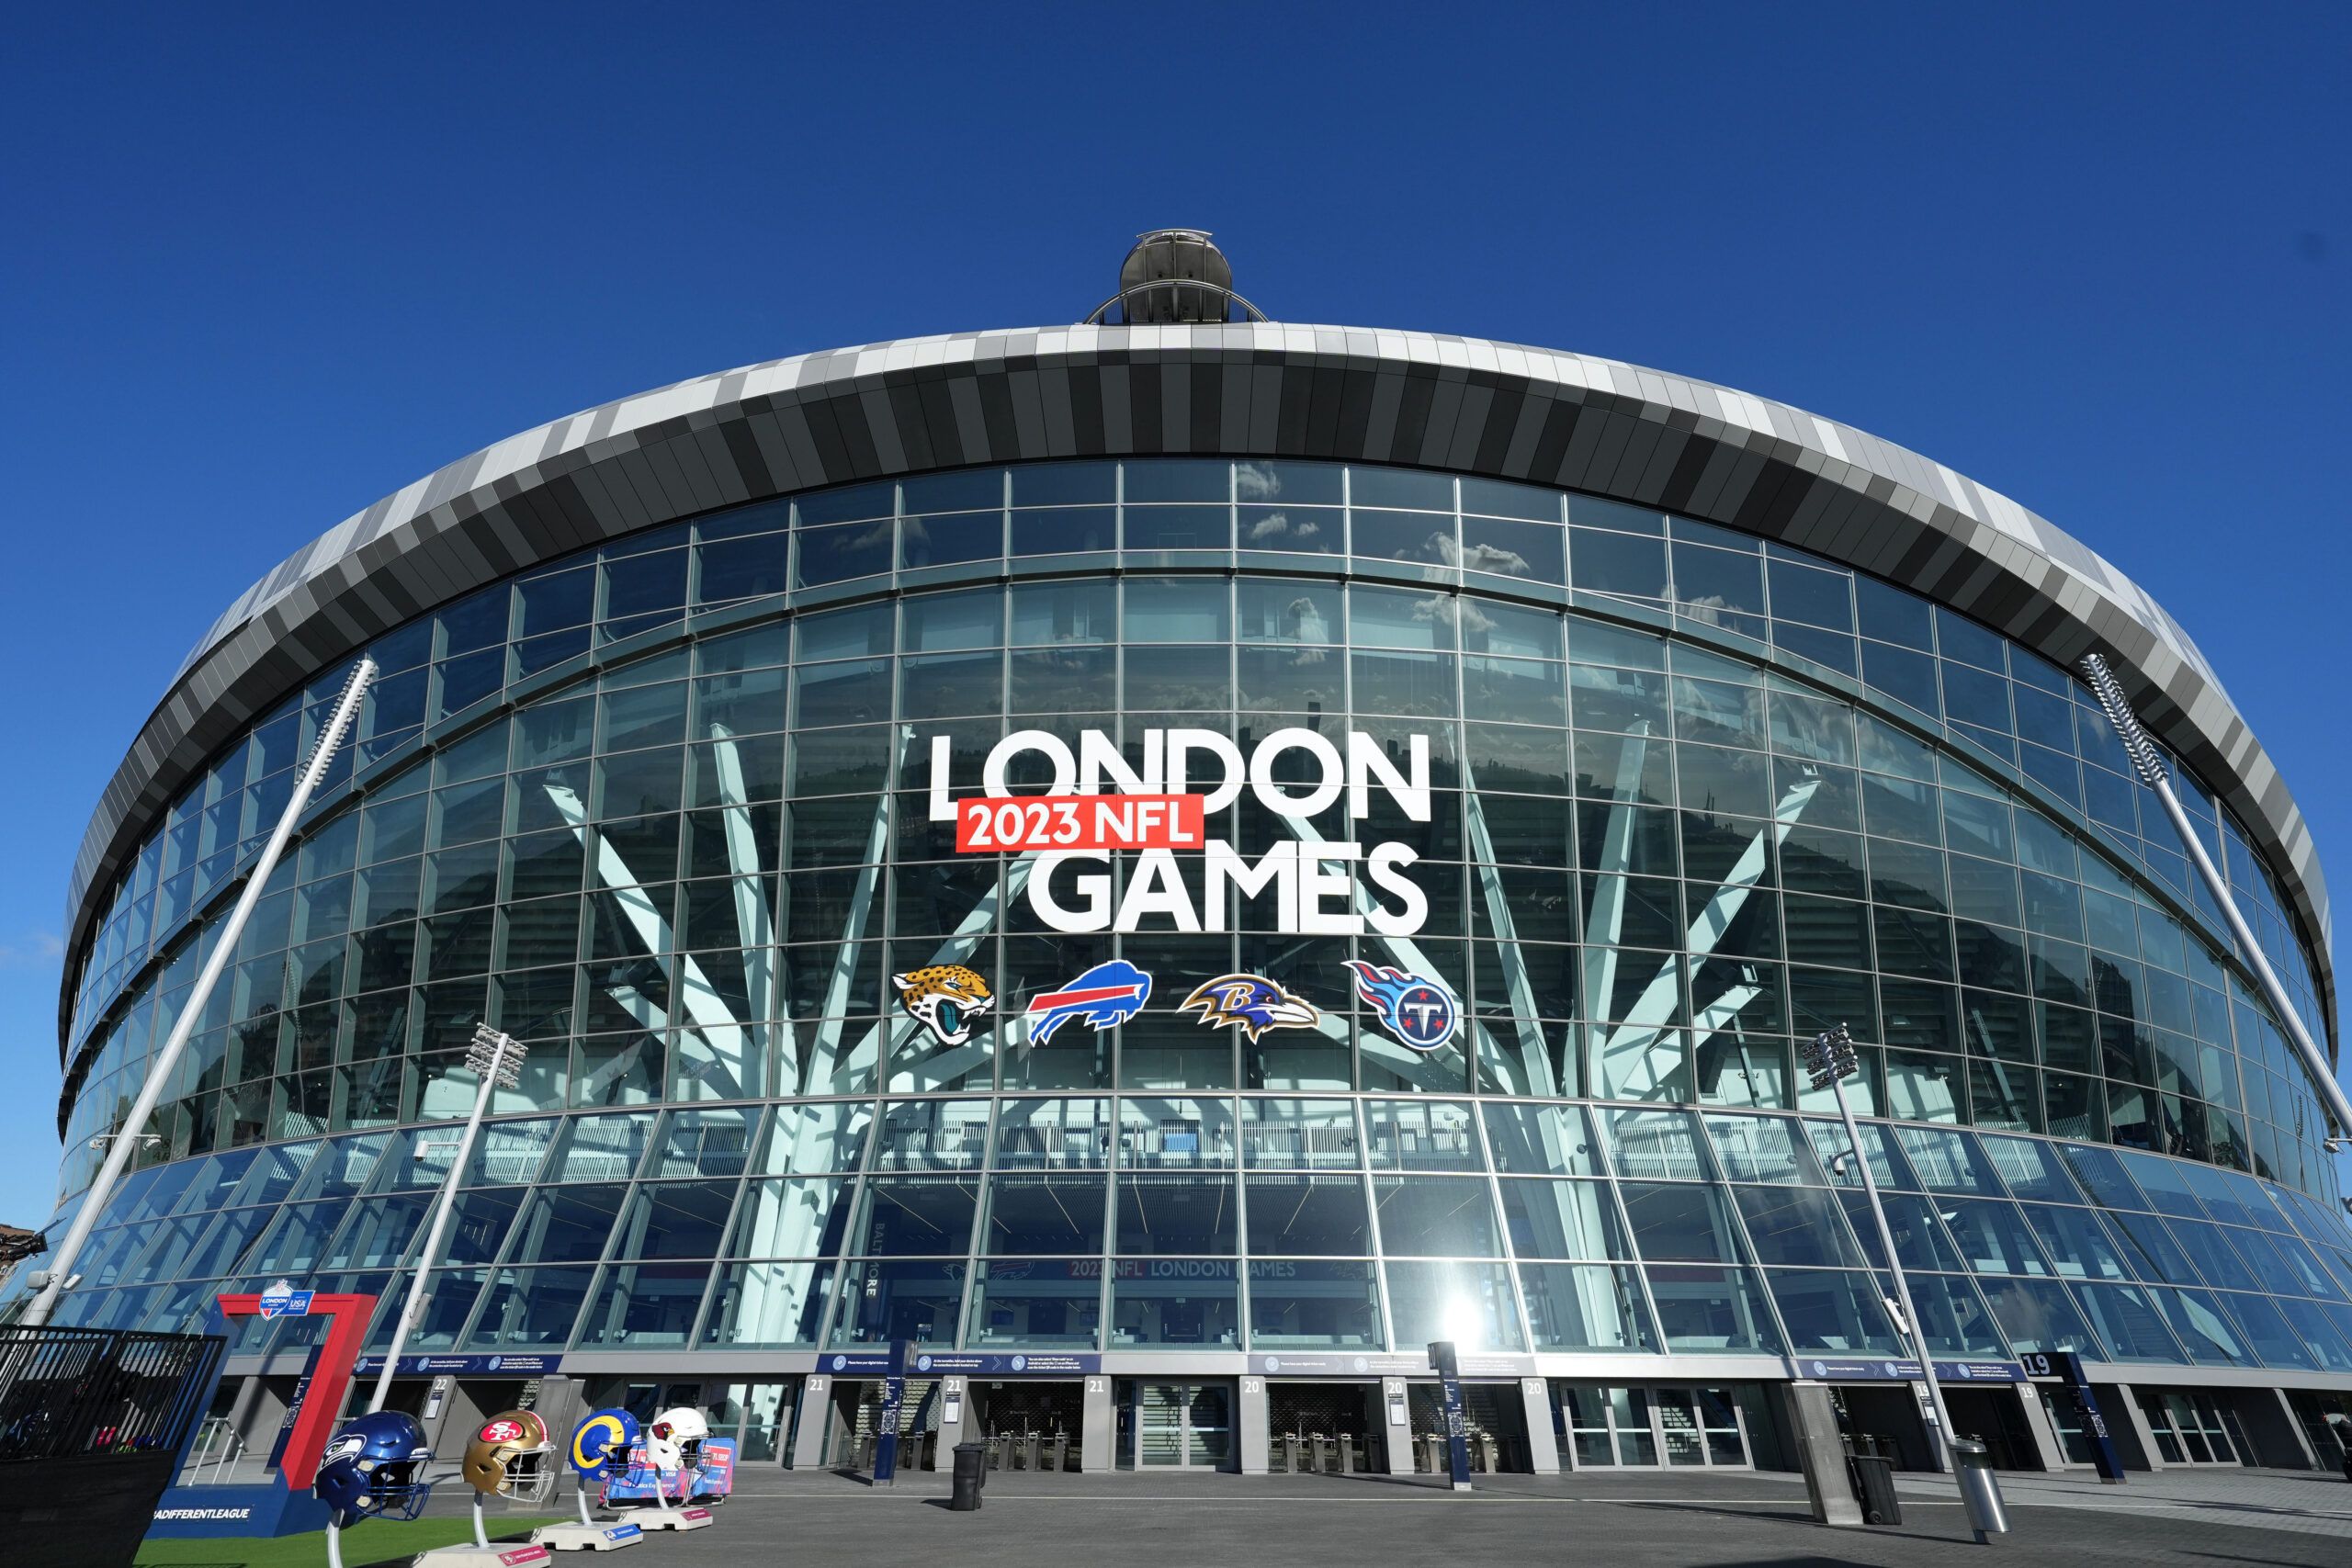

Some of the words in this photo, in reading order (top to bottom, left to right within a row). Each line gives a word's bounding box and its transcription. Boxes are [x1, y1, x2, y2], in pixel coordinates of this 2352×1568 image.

[929, 728, 1431, 822] LONDON
[966, 802, 1081, 846] 2023
[1095, 800, 1194, 842] NFL
[1027, 840, 1429, 936] GAMES
[866, 1223, 886, 1296] BALTORE
[1114, 1260, 1143, 1277] NFL
[1150, 1260, 1229, 1277] LONDON
[1237, 1260, 1296, 1277] AMES
[2022, 1354, 2051, 1375] 19
[435, 1379, 447, 1390] 22
[809, 1379, 823, 1391] 21
[946, 1380, 961, 1392] 21
[1089, 1380, 1104, 1393] 21
[1244, 1381, 1260, 1393] 20
[1387, 1382, 1403, 1393] 20
[1527, 1382, 1542, 1394] 20
[1917, 1385, 1930, 1396] 19
[2021, 1387, 2034, 1398] 19
[153, 1508, 251, 1520] ADIFFERENTLEAGUE
